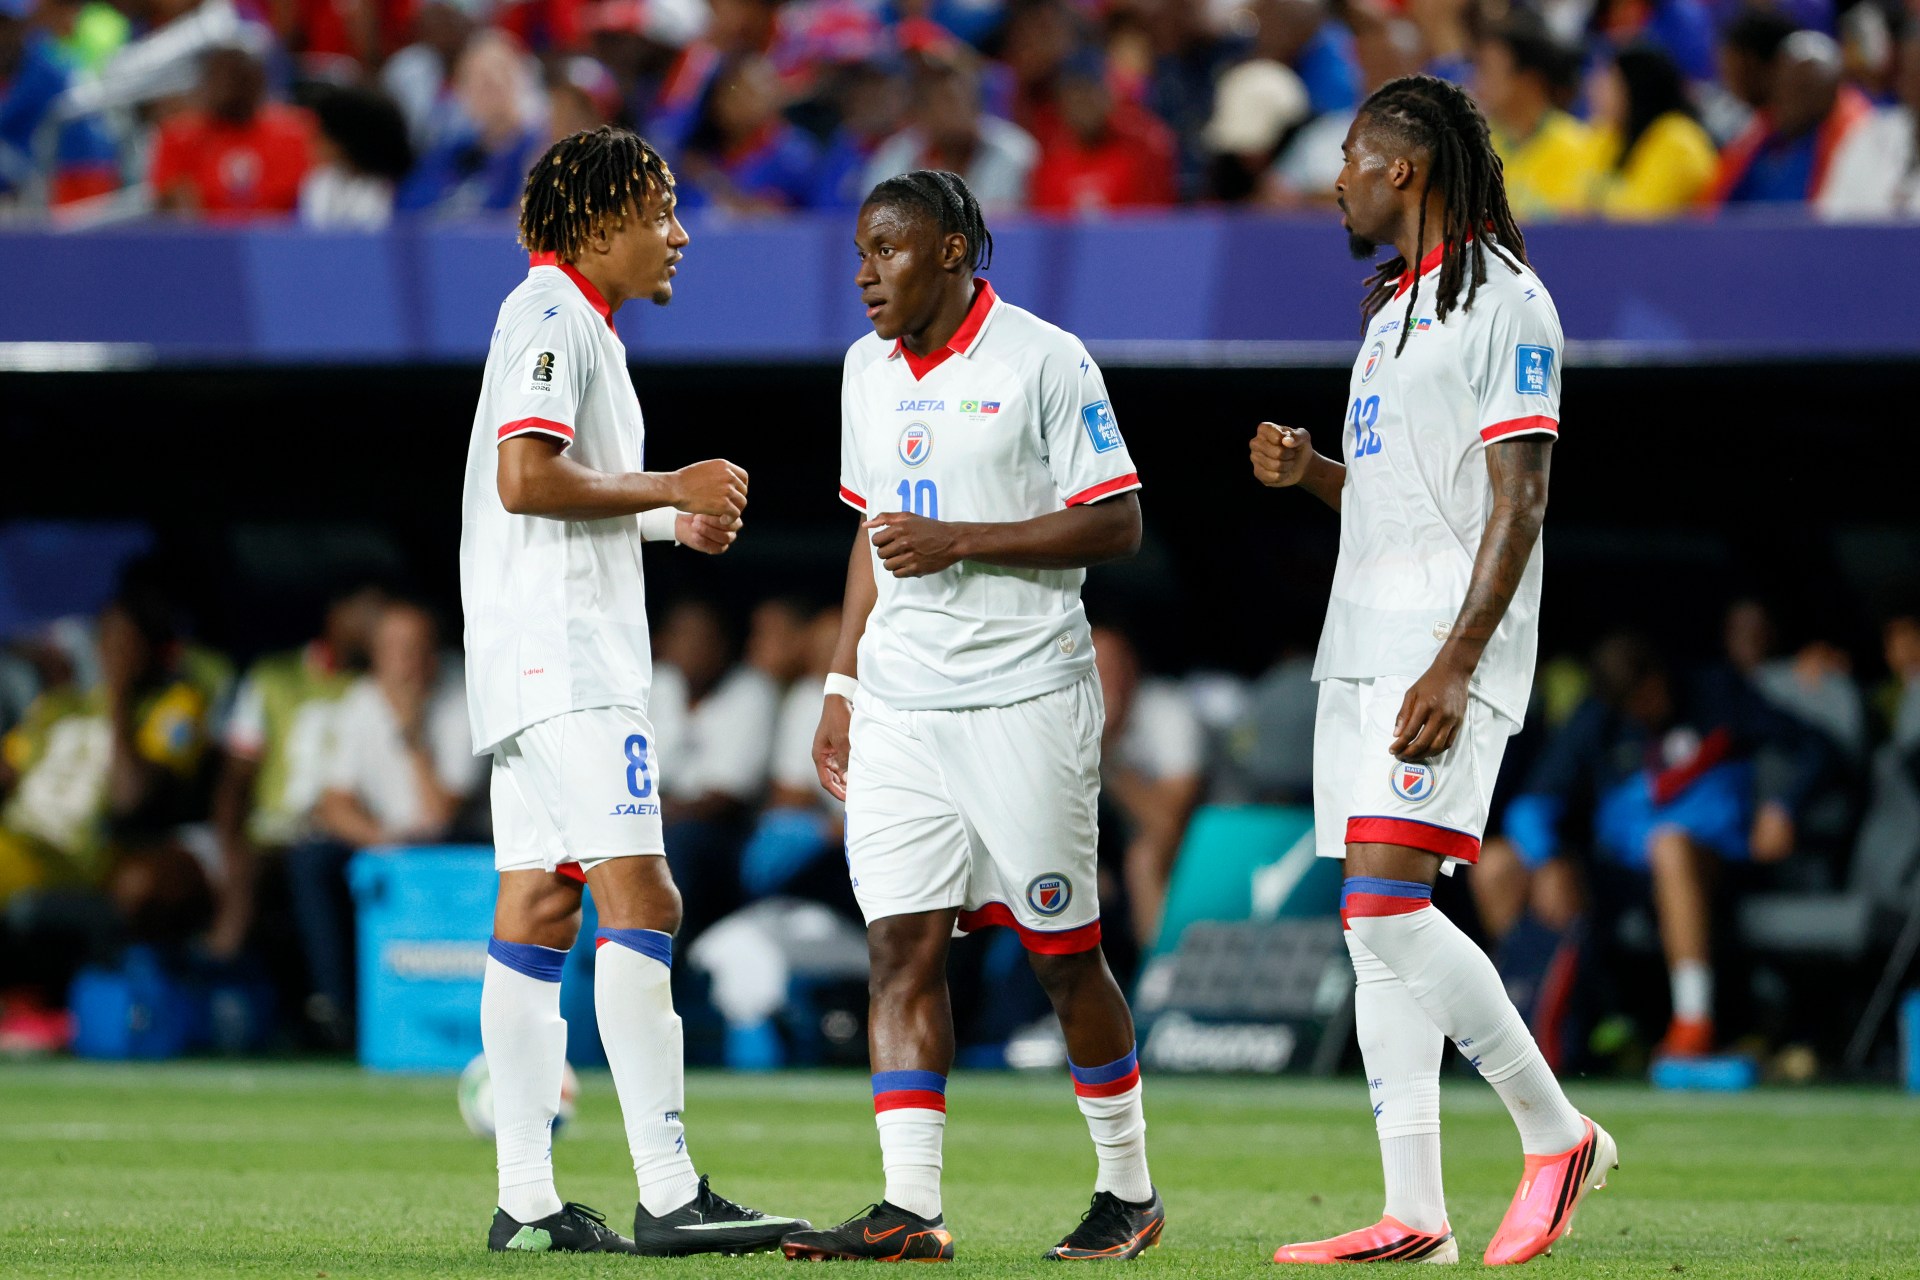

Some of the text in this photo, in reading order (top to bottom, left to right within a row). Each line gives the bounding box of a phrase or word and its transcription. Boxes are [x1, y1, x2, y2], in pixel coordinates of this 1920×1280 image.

[895, 400, 945, 411] SAETA
[1349, 395, 1382, 459] 22
[896, 479, 938, 520] 10
[624, 734, 652, 798] 8
[1405, 766, 1424, 774] HAITI
[608, 803, 659, 815] SAETA
